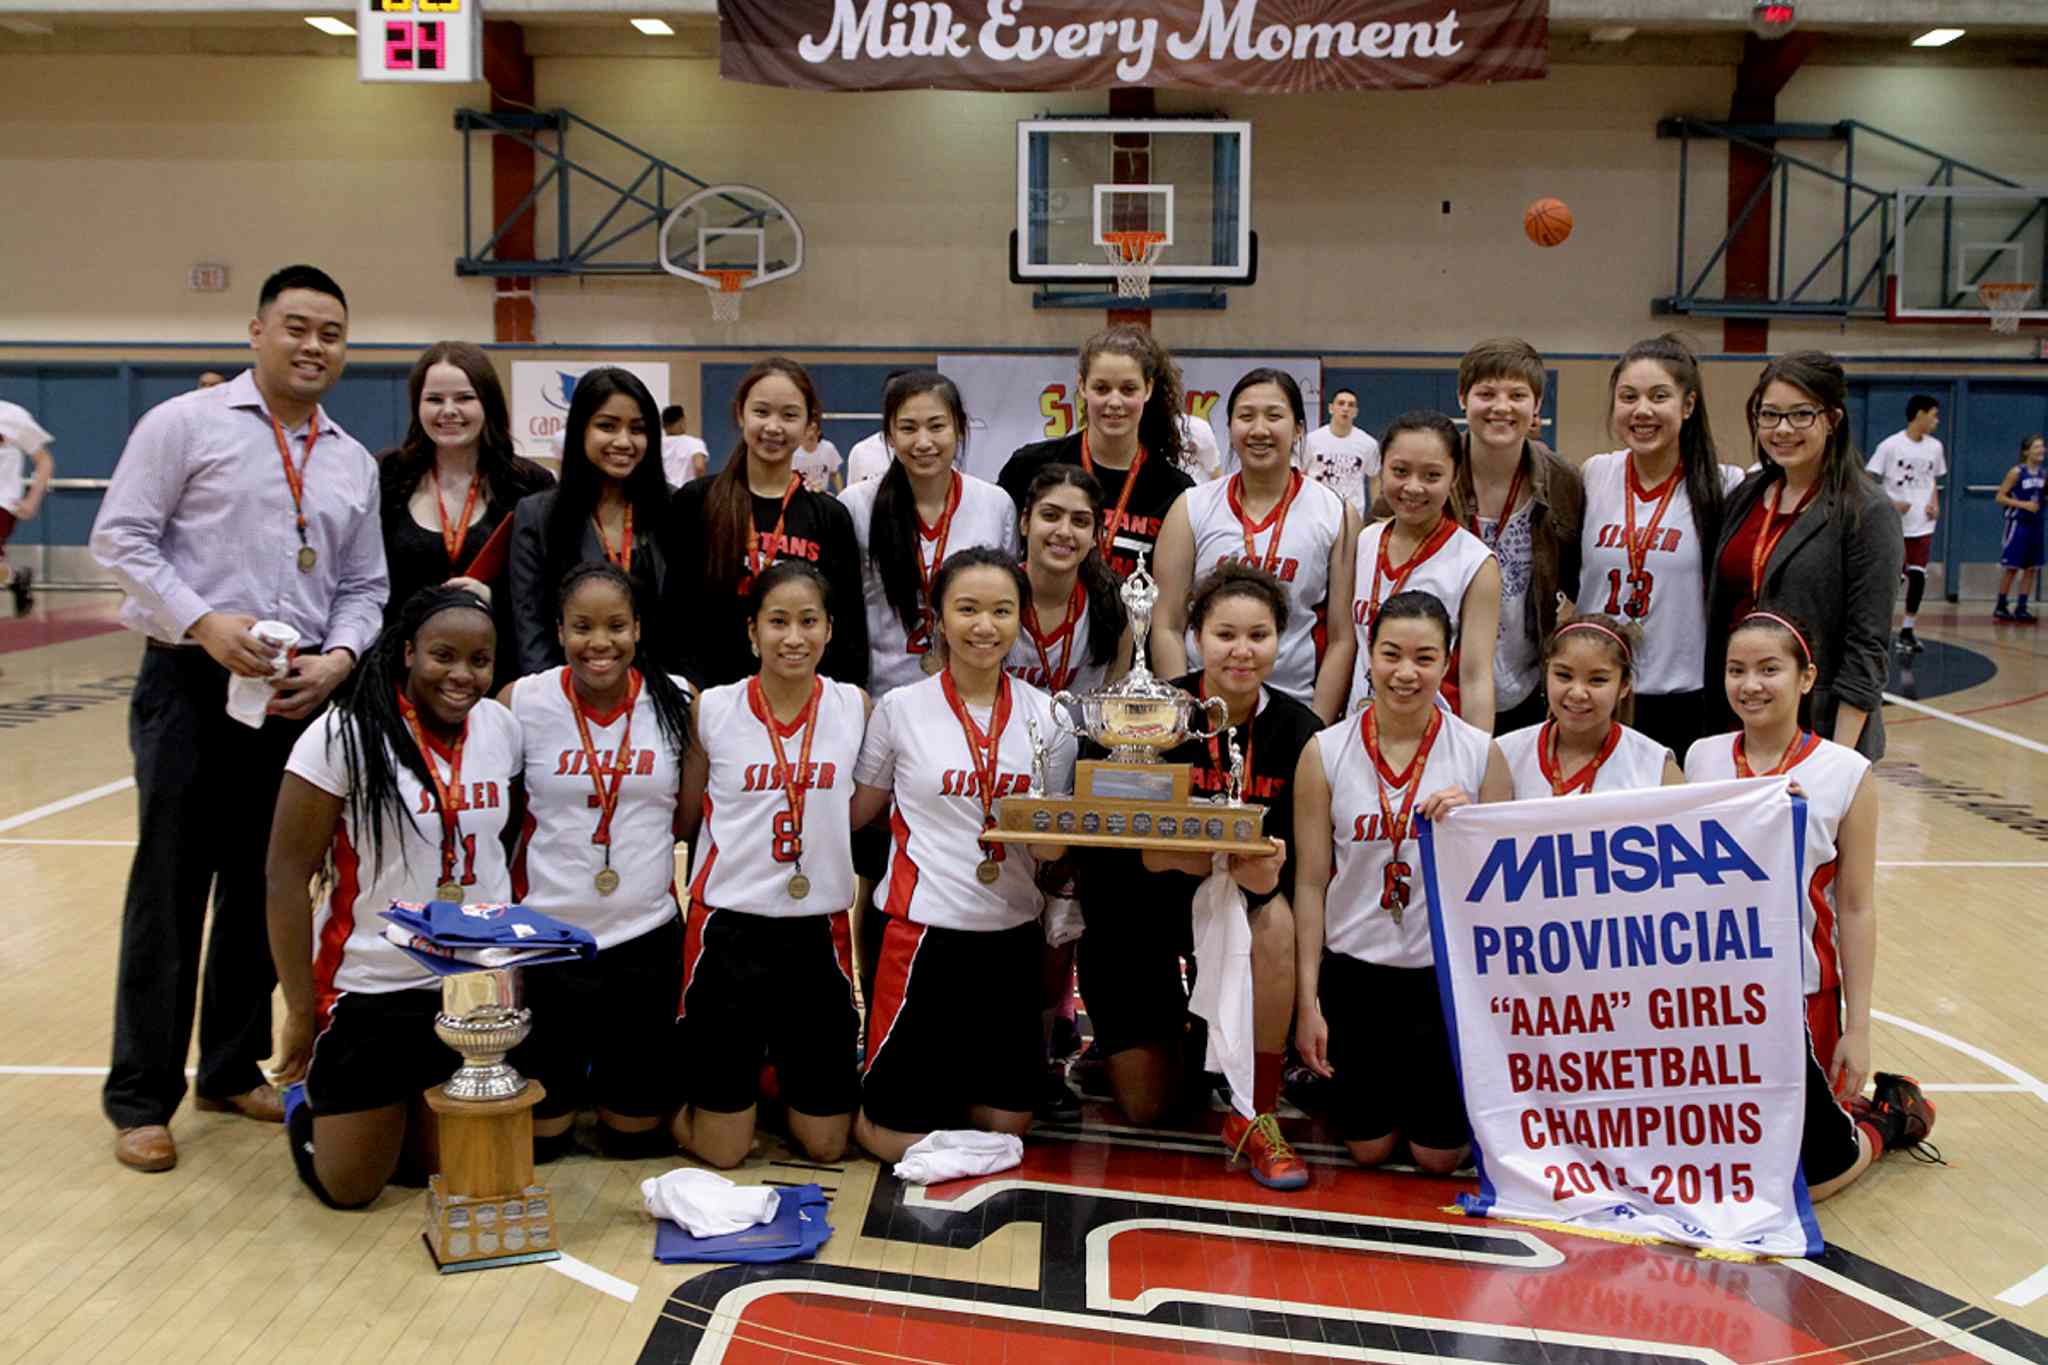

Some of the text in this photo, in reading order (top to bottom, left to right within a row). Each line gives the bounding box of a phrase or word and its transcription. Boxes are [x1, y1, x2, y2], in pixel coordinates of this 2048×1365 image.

[384, 21, 446, 70] 24
[798, 0, 1464, 82] Milk Every Moment
[1604, 568, 1654, 618] 13
[771, 811, 803, 863] 8
[1465, 818, 1770, 903] MHSAA
[1473, 906, 1774, 976] PROVINCIAL
[1648, 982, 1767, 1030] GIRLS
[1507, 1043, 1761, 1094] BASKETBALL
[1520, 1101, 1762, 1150] CHAMPIONS
